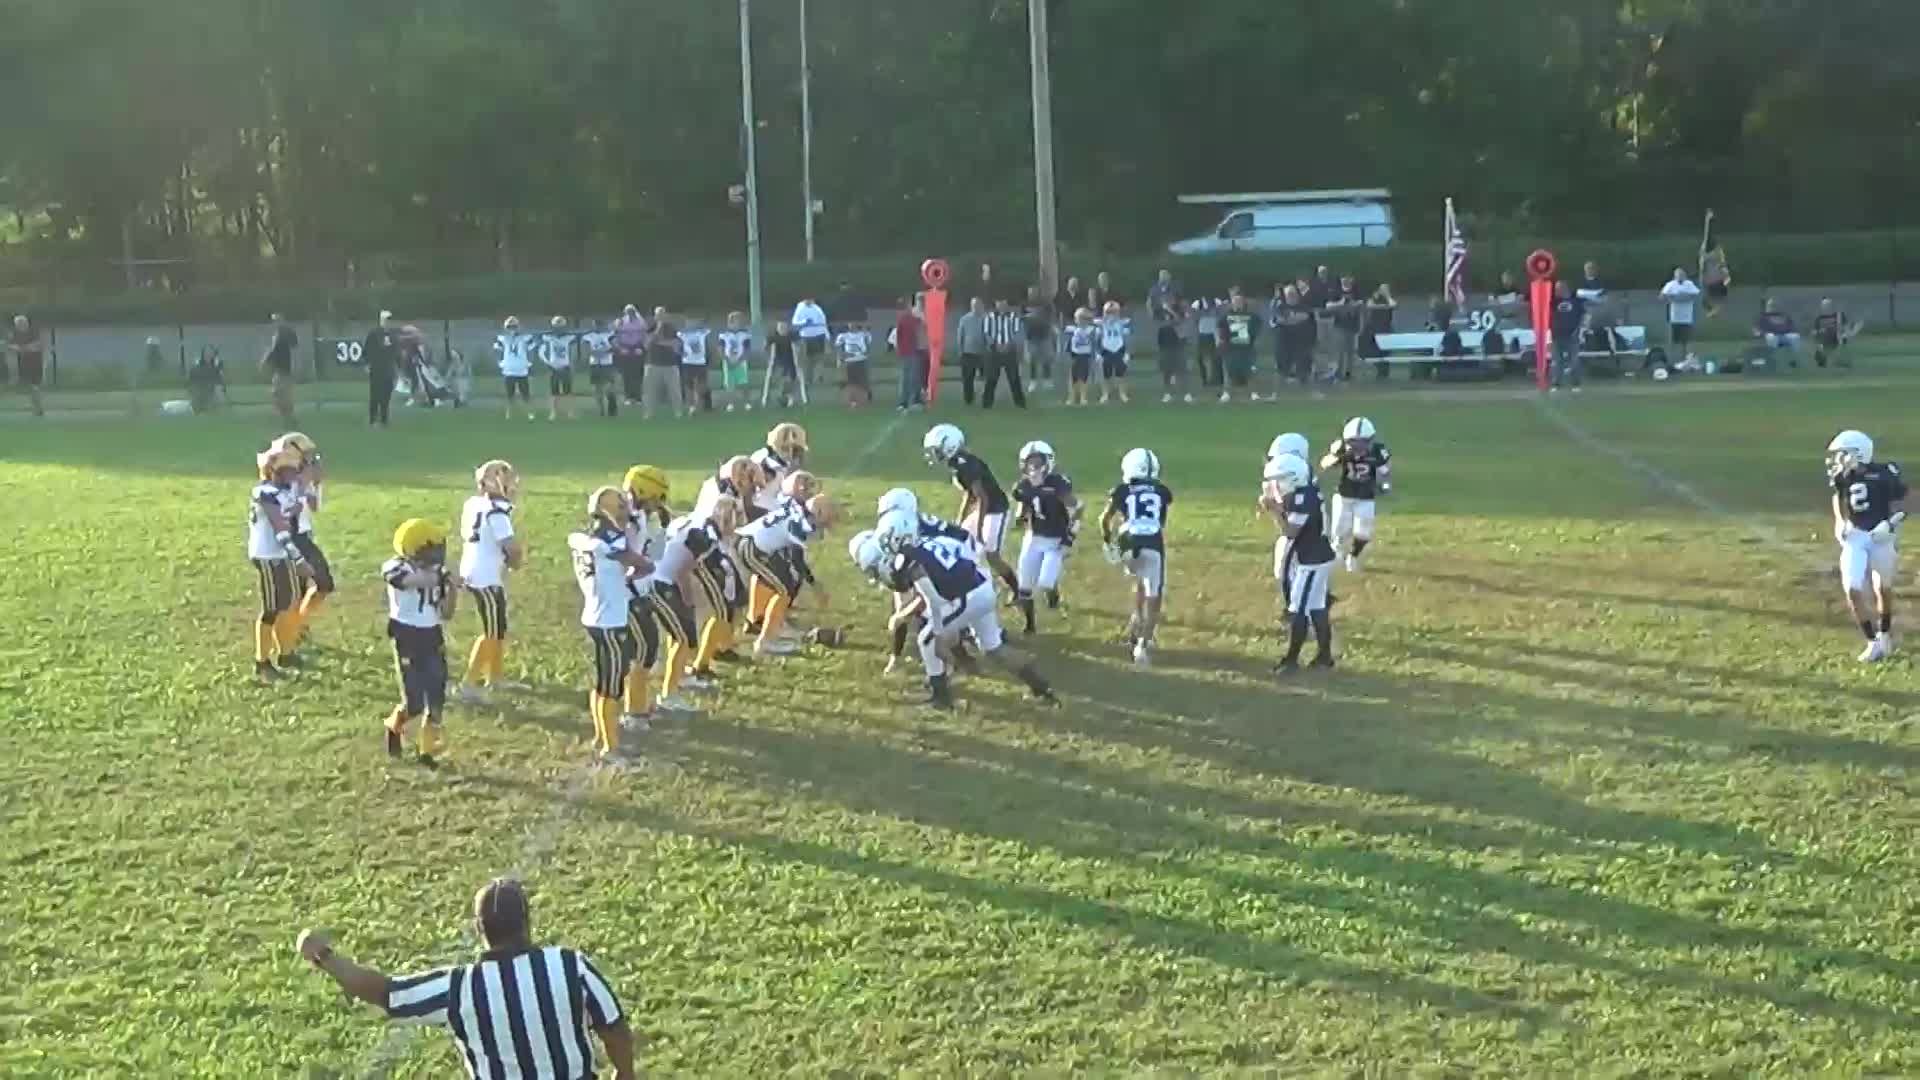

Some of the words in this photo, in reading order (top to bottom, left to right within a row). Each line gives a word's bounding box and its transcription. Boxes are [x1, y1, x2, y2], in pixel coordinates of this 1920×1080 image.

[1470, 310, 1496, 331] 50
[336, 341, 362, 362] 30
[1032, 495, 1046, 520] 1
[1125, 492, 1161, 520] 13
[1849, 482, 1870, 512] 2
[472, 511, 483, 544] 1
